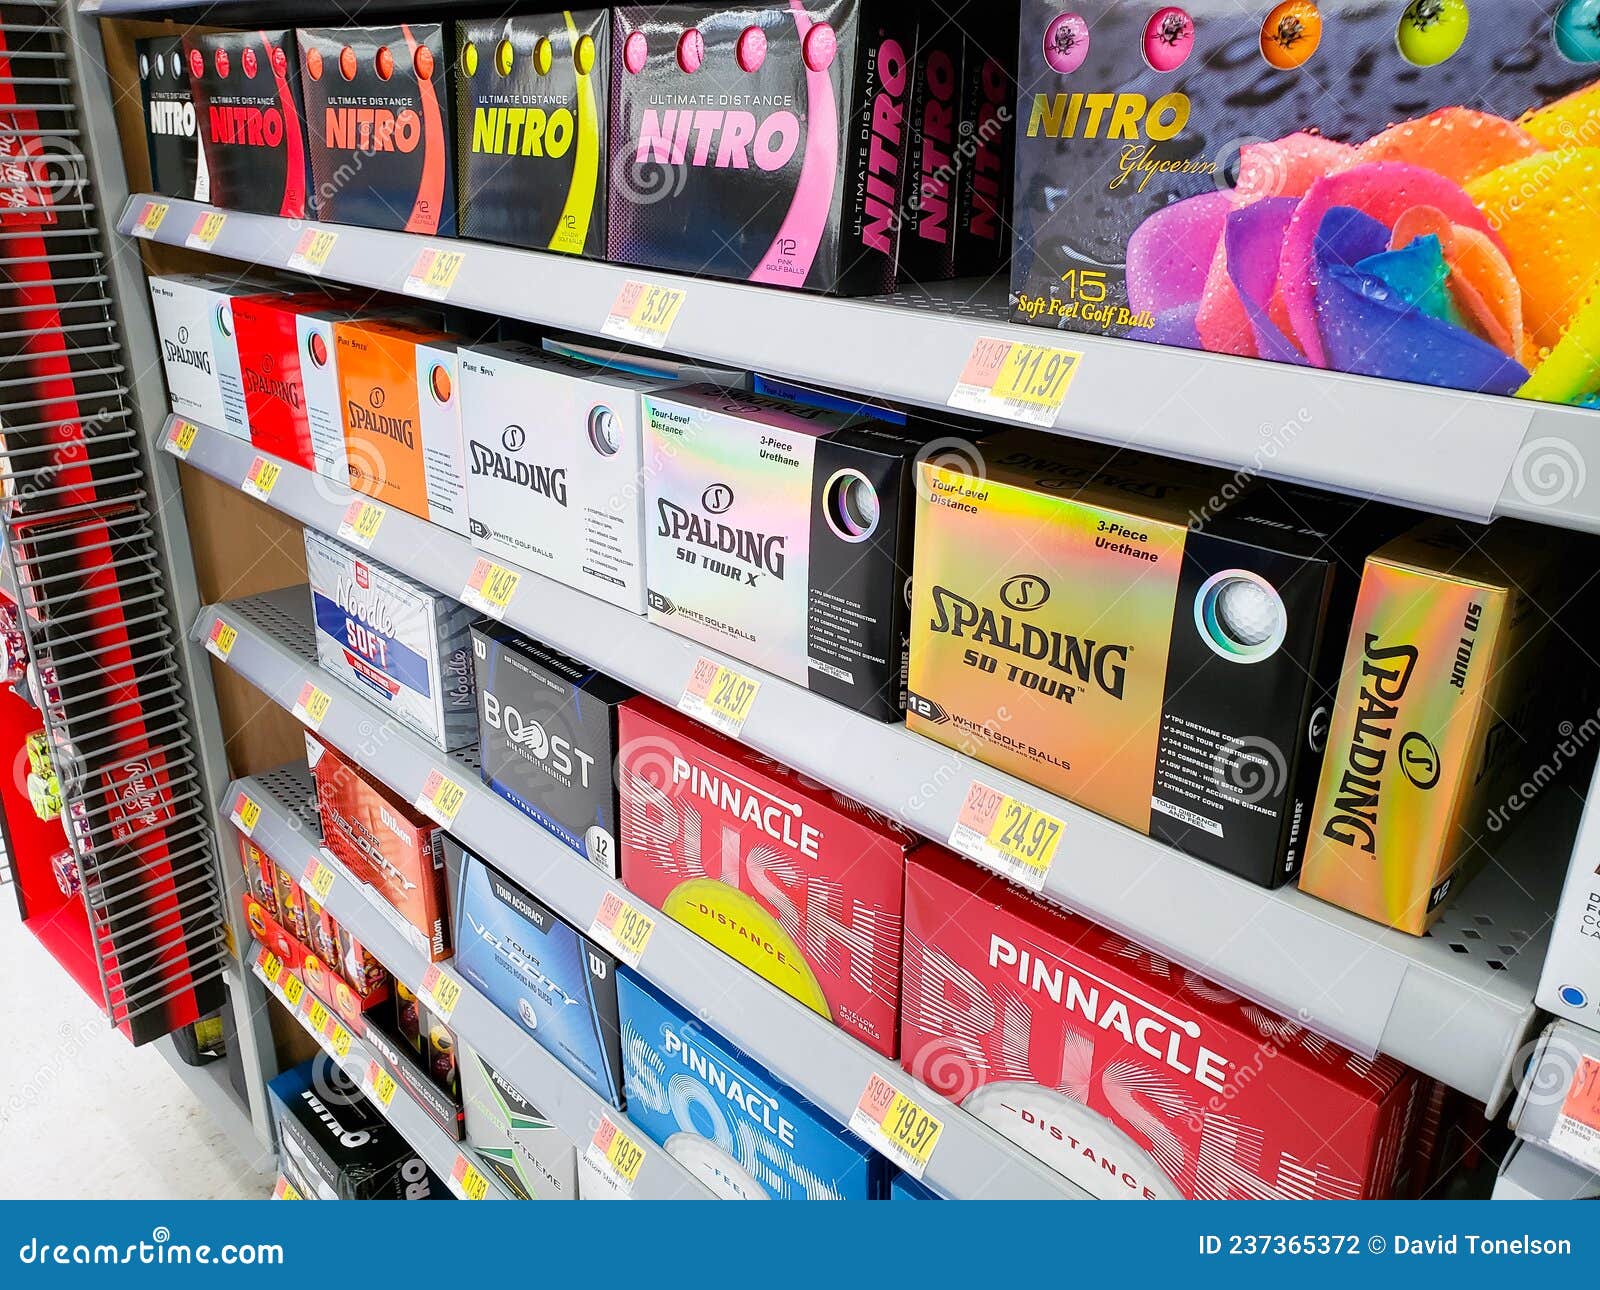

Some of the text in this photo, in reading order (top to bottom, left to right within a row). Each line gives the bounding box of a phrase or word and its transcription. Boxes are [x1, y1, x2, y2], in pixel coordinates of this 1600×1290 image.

[242, 97, 274, 105] DISTANCE
[328, 97, 412, 106] ULTIMATE DISTANCE
[479, 96, 568, 104] ULTIMATE DISTANCE
[650, 95, 792, 106] ULTIMATE DISTANCE
[1026, 92, 1191, 141] NITRO
[150, 101, 196, 137] NITRO
[209, 106, 283, 147] NITRO
[325, 107, 421, 153] NITRO
[472, 107, 574, 159] NITRO
[635, 109, 800, 171] NITRO
[853, 48, 877, 236] ULTIMATE DISTANCE
[862, 38, 906, 256] NITRO
[910, 63, 926, 231] ULTIMATE DISTANCE
[919, 50, 954, 244] NITRO
[1109, 144, 1218, 193] Glycerin
[416, 200, 429, 213] 12
[562, 215, 576, 230] 12
[777, 239, 797, 256] 12
[778, 258, 793, 266] PINK
[766, 264, 805, 276] GOLF BALLS
[1061, 268, 1107, 302] 15
[1018, 294, 1156, 329] Soft Feel Golf Balls
[164, 338, 211, 376] SPALDING
[1014, 350, 1076, 398] $11.97
[244, 367, 300, 410] SPALDING
[348, 400, 414, 450] SPALDING
[651, 407, 690, 424] Tour-Level
[651, 420, 684, 436] Distance
[759, 450, 800, 469] Urethane
[760, 436, 793, 453] 3-Piece
[470, 440, 568, 508] SPALDING
[932, 478, 988, 502] Tour-Level
[930, 493, 978, 514] Distance
[470, 520, 484, 535] 12
[493, 530, 554, 560] WHITE GOLF BALLS
[657, 497, 785, 581] SPALDING
[1096, 520, 1148, 543] 3-Piece
[676, 547, 759, 587] SD TOUR X
[1095, 538, 1159, 563] Urethane
[336, 574, 396, 639] Noodle
[649, 594, 664, 610] 12
[842, 608, 877, 624] CONSTRUCTION
[846, 600, 861, 609] COVER
[677, 605, 704, 621] WHITE
[704, 616, 727, 629] GOLF
[728, 624, 756, 642] BALLS
[346, 618, 388, 670] SOFT
[862, 652, 886, 664] DISTANCE
[930, 586, 1128, 700] SPALDING
[450, 647, 471, 706] Noodle
[900, 652, 910, 686] TOUR
[963, 648, 1077, 704] SD TOUR
[1450, 638, 1475, 687] TOUR
[714, 672, 755, 715] $24.97
[908, 696, 932, 717] 12
[952, 714, 1071, 770] WHITE GOLF BALLS
[1169, 727, 1269, 766] 3-PIECE TOUR CONSTRUCTION
[1171, 714, 1246, 747] TPU URETHANE COVER
[1324, 632, 1420, 856] SPALDING
[1178, 752, 1225, 776] COMPRESSION
[1182, 743, 1208, 758] DIMPLE
[1208, 751, 1240, 769] PATTERN
[1164, 772, 1278, 818] CONSISTENT ACCURATE DISTANCE
[1166, 760, 1244, 794] LOW SPIN HIGH SPEED
[672, 755, 819, 861] PINNACLE
[968, 784, 1002, 820] $24.97
[1155, 798, 1218, 828] TOUR DISTANCE
[1164, 782, 1224, 812] EXTRA-SOFT COVER
[380, 806, 412, 848] Wilson
[506, 792, 580, 849] EXTREME DISTANCE
[1000, 804, 1059, 862] $24.97
[1168, 808, 1207, 829] AND FEEL
[1286, 800, 1304, 872] SD TOUR
[595, 836, 608, 858] 12
[496, 882, 544, 927] TOUR ACCURACY
[432, 919, 444, 955] Wilson
[621, 908, 652, 948] $19.97
[699, 904, 786, 964] DISTANCE
[466, 912, 579, 1005] VELOCITY
[505, 935, 540, 966] TOUR
[839, 1010, 880, 1040] GOLF BALLS
[848, 1008, 876, 1030] YELLOW
[988, 932, 1229, 1094] PINNACLE
[492, 1070, 528, 1109] PRECEPT
[666, 1029, 797, 1150] PINNACLE
[868, 1076, 896, 1109] $19.97
[896, 1099, 938, 1154] $19.97
[616, 1136, 642, 1177] $19.97
[1021, 1109, 1157, 1200] DISTANCE
